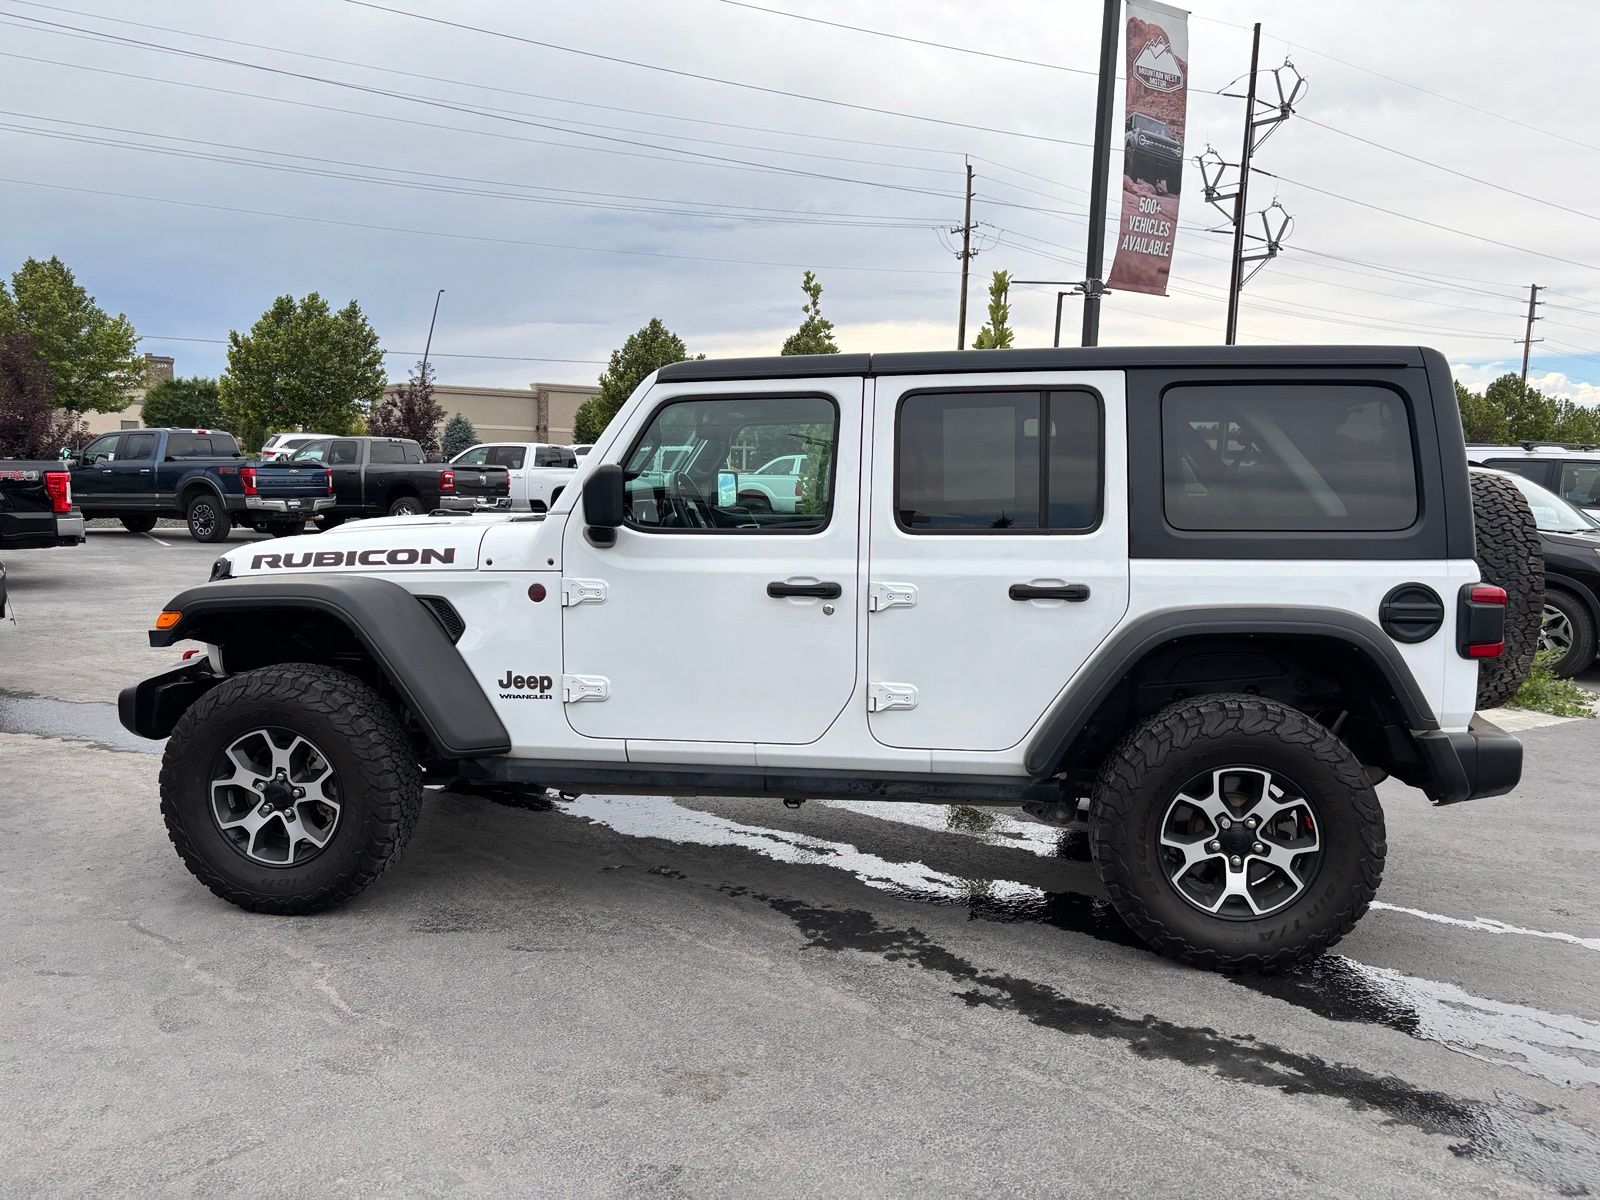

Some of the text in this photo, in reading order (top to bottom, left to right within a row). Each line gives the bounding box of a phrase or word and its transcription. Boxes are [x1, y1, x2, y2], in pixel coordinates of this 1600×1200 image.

[1138, 66, 1178, 83] MOUNTAIN WEST
[1149, 76, 1167, 88] MOTOR
[1138, 196, 1162, 214] 500+
[1129, 215, 1171, 237] VEHICLES
[1121, 234, 1172, 257] AVAILABLE
[250, 548, 456, 570] RUBICON
[498, 670, 553, 693] Jeep
